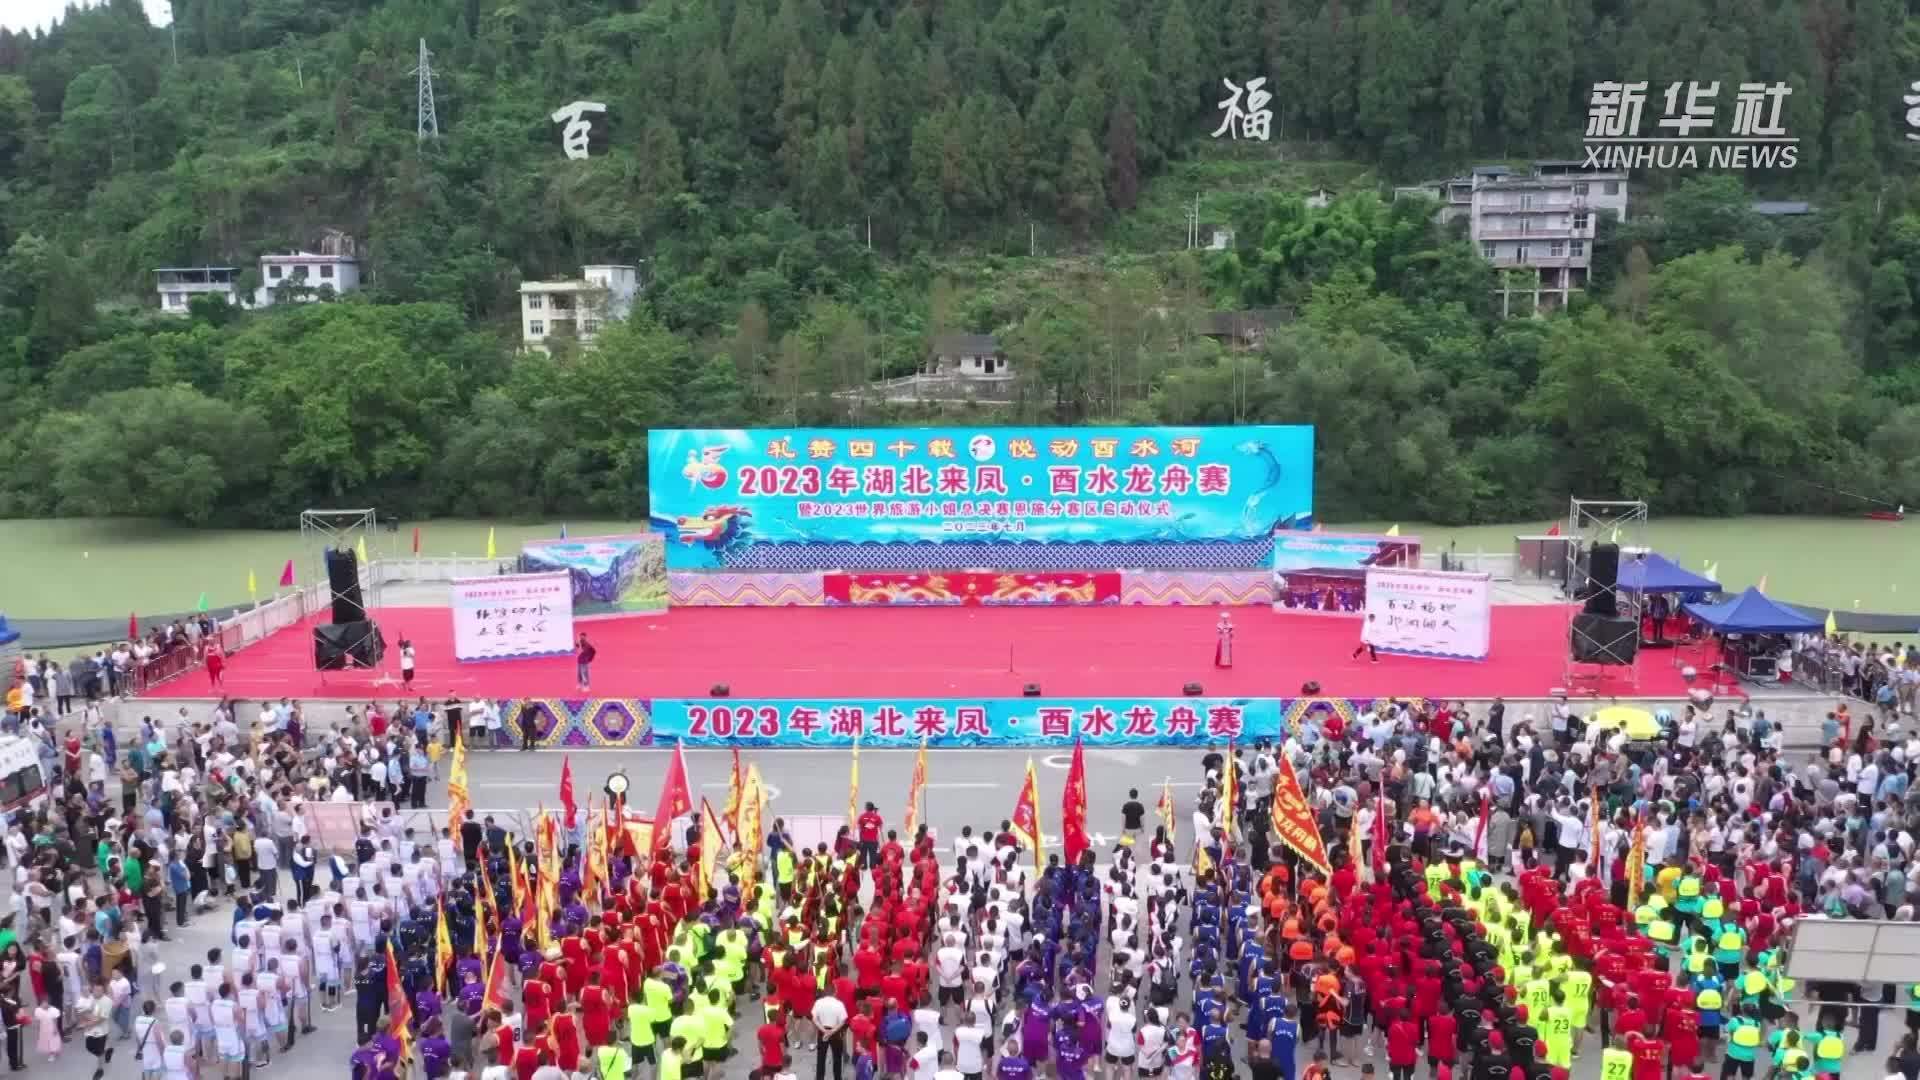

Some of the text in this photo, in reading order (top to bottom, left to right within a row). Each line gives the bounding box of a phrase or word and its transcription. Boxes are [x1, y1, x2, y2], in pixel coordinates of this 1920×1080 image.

[1212, 77, 1273, 141] 福
[551, 101, 607, 161] 百
[767, 438, 1201, 459] 礼赞四十载 悦动酉水河
[740, 465, 1230, 494] 2023年湖北来凤·酉水龙舟赛
[689, 706, 1243, 738] 2023年湖北来凤·酉水龙舟赛
